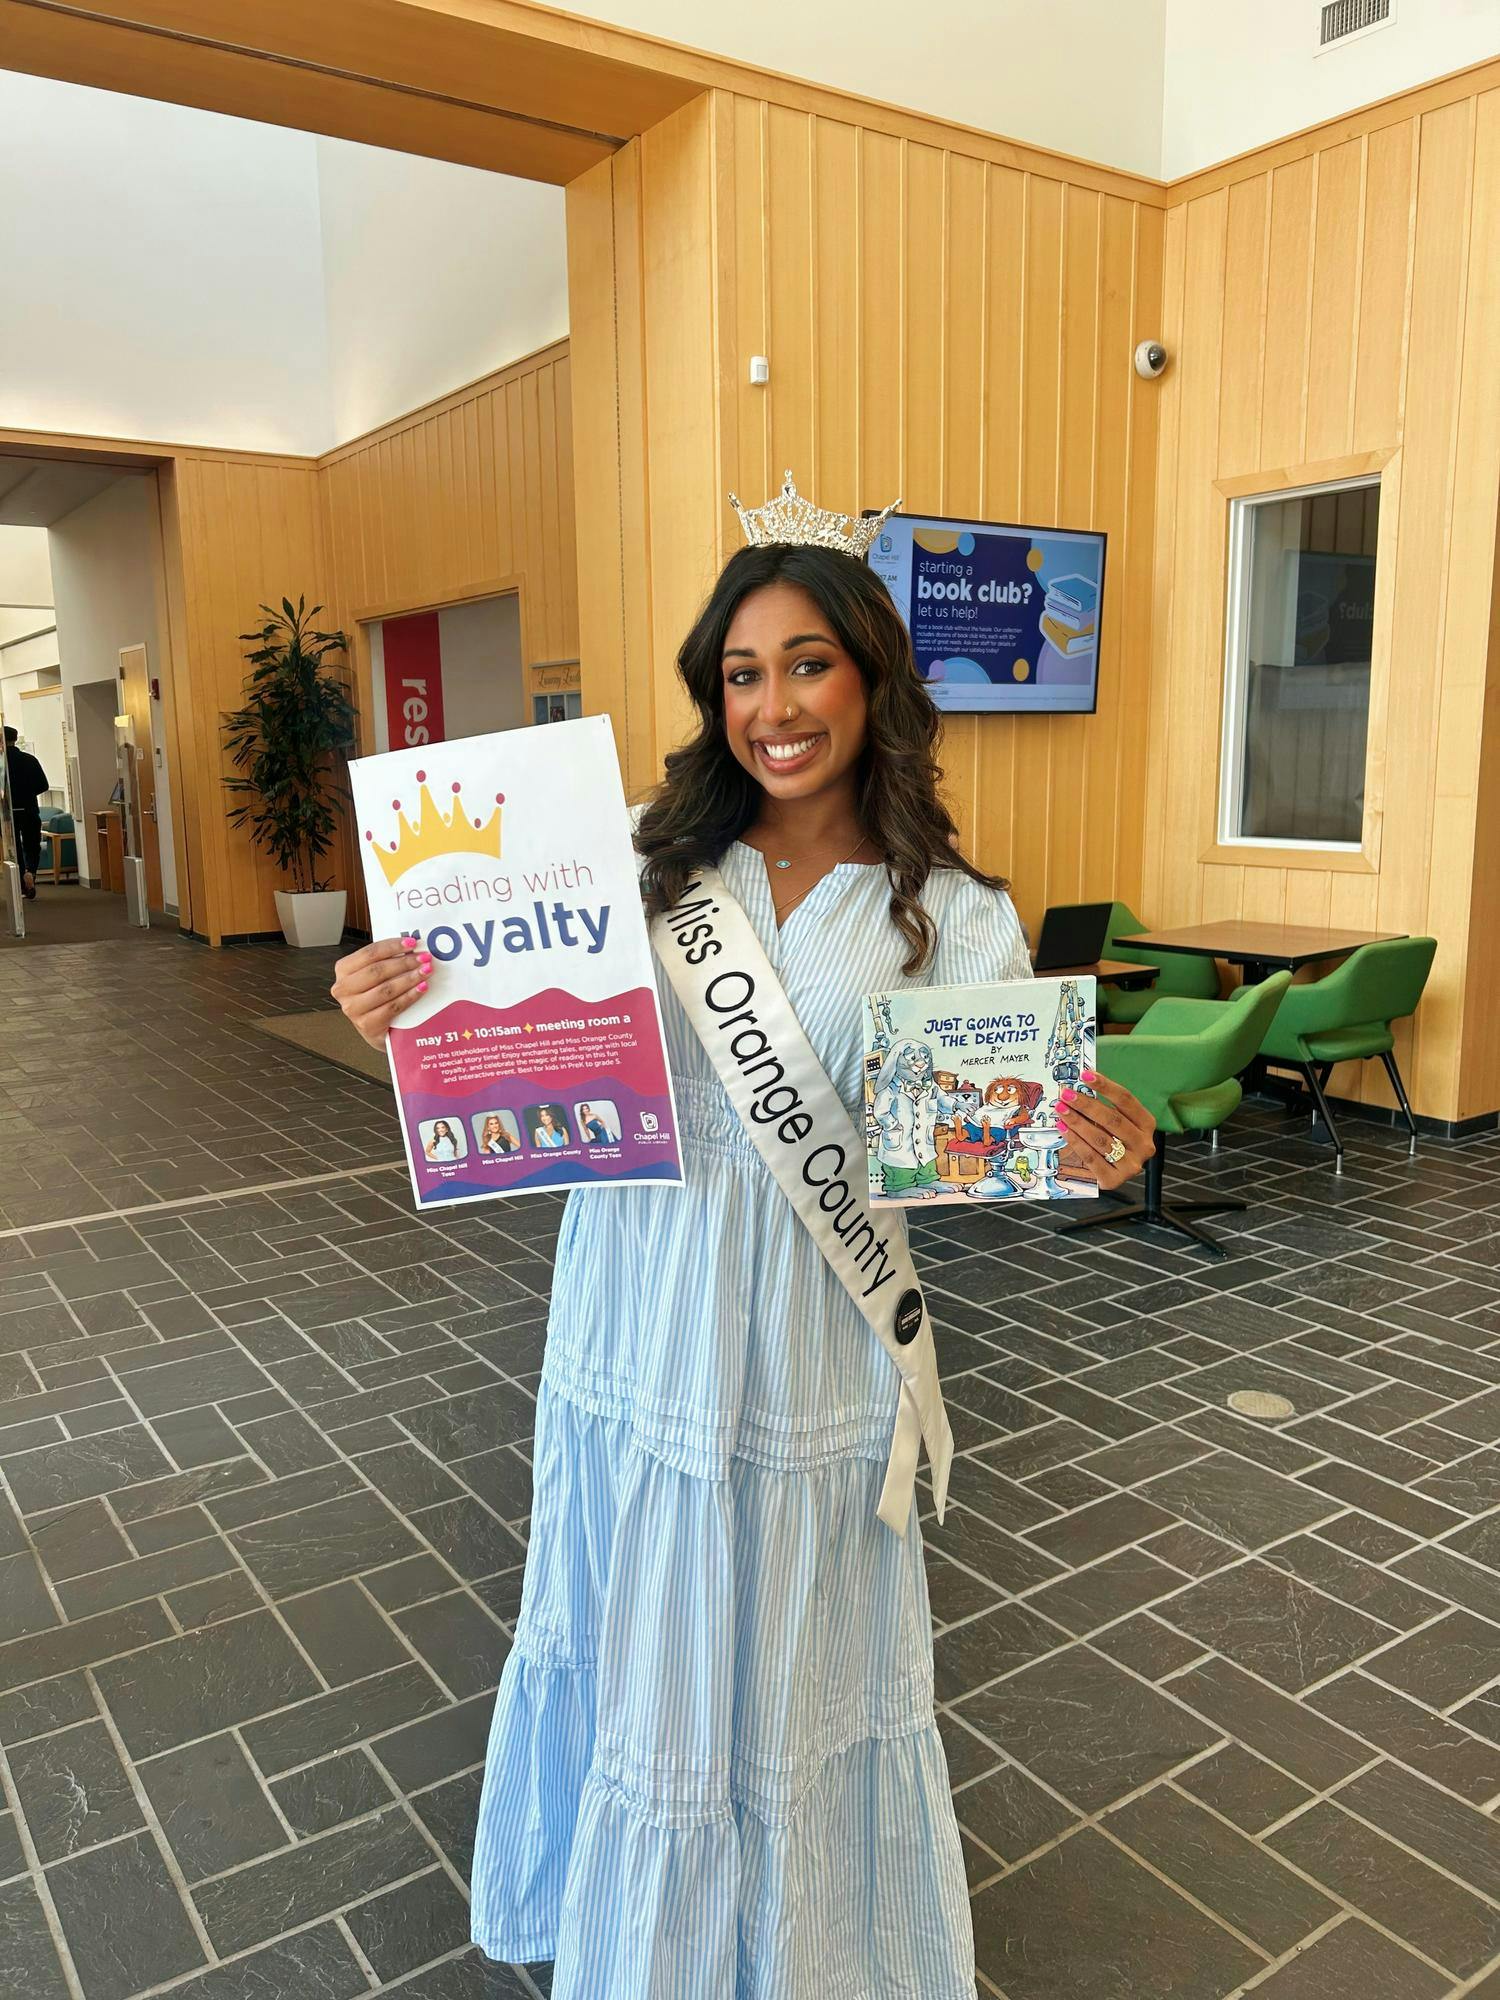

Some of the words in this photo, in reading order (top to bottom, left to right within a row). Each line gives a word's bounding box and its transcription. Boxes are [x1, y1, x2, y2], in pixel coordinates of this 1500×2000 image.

[920, 560, 963, 577] starting
[966, 565, 973, 576] a
[918, 575, 973, 601] book
[978, 580, 1033, 604] club?
[918, 603, 932, 617] let
[935, 607, 949, 618] us
[951, 605, 978, 620] help!
[402, 678, 430, 746] res
[396, 875, 512, 911] reading
[523, 860, 594, 893] with
[416, 1035, 442, 1047] may
[445, 1031, 459, 1042] 31
[474, 1025, 522, 1038] 10:15am
[536, 1019, 585, 1032] meeting
[587, 1015, 620, 1026] room
[623, 1014, 631, 1023] a
[924, 1017, 962, 1034] JUST
[966, 1015, 1011, 1030] GOING
[1016, 1013, 1035, 1027] TO
[422, 1054, 437, 1062] Join
[451, 1047, 489, 1057] titleholders
[515, 1041, 539, 1050] Chapel
[581, 1035, 606, 1044] Orange
[608, 1032, 633, 1041] County
[940, 1034, 968, 1047] THE
[975, 1028, 1040, 1044] DENTIST
[439, 1058, 463, 1069] special
[464, 1055, 482, 1065] story
[501, 1051, 519, 1060] Enjoy
[521, 1047, 558, 1058] enchanting
[578, 1044, 603, 1053] engage
[991, 1046, 1002, 1054] BY
[484, 1060, 515, 1070] celebrate
[529, 1057, 549, 1067] magic
[559, 1053, 584, 1063] reading
[960, 1056, 995, 1067] MERCER
[1000, 1054, 1030, 1064] MAYER
[443, 1076, 457, 1084] and
[458, 1070, 495, 1081] interactive
[517, 1066, 533, 1074] Best
[568, 1061, 584, 1069] PreK
[594, 1058, 614, 1068] grade
[667, 881, 722, 964] Miss
[705, 971, 813, 1145] Orange
[803, 1144, 896, 1297] County
[634, 1133, 659, 1142] Chapel
[659, 1132, 671, 1140] Hill
[495, 1156, 514, 1164] Chapel
[543, 1151, 562, 1159] Orange
[563, 1149, 581, 1157] County
[439, 1165, 458, 1173] Chapel
